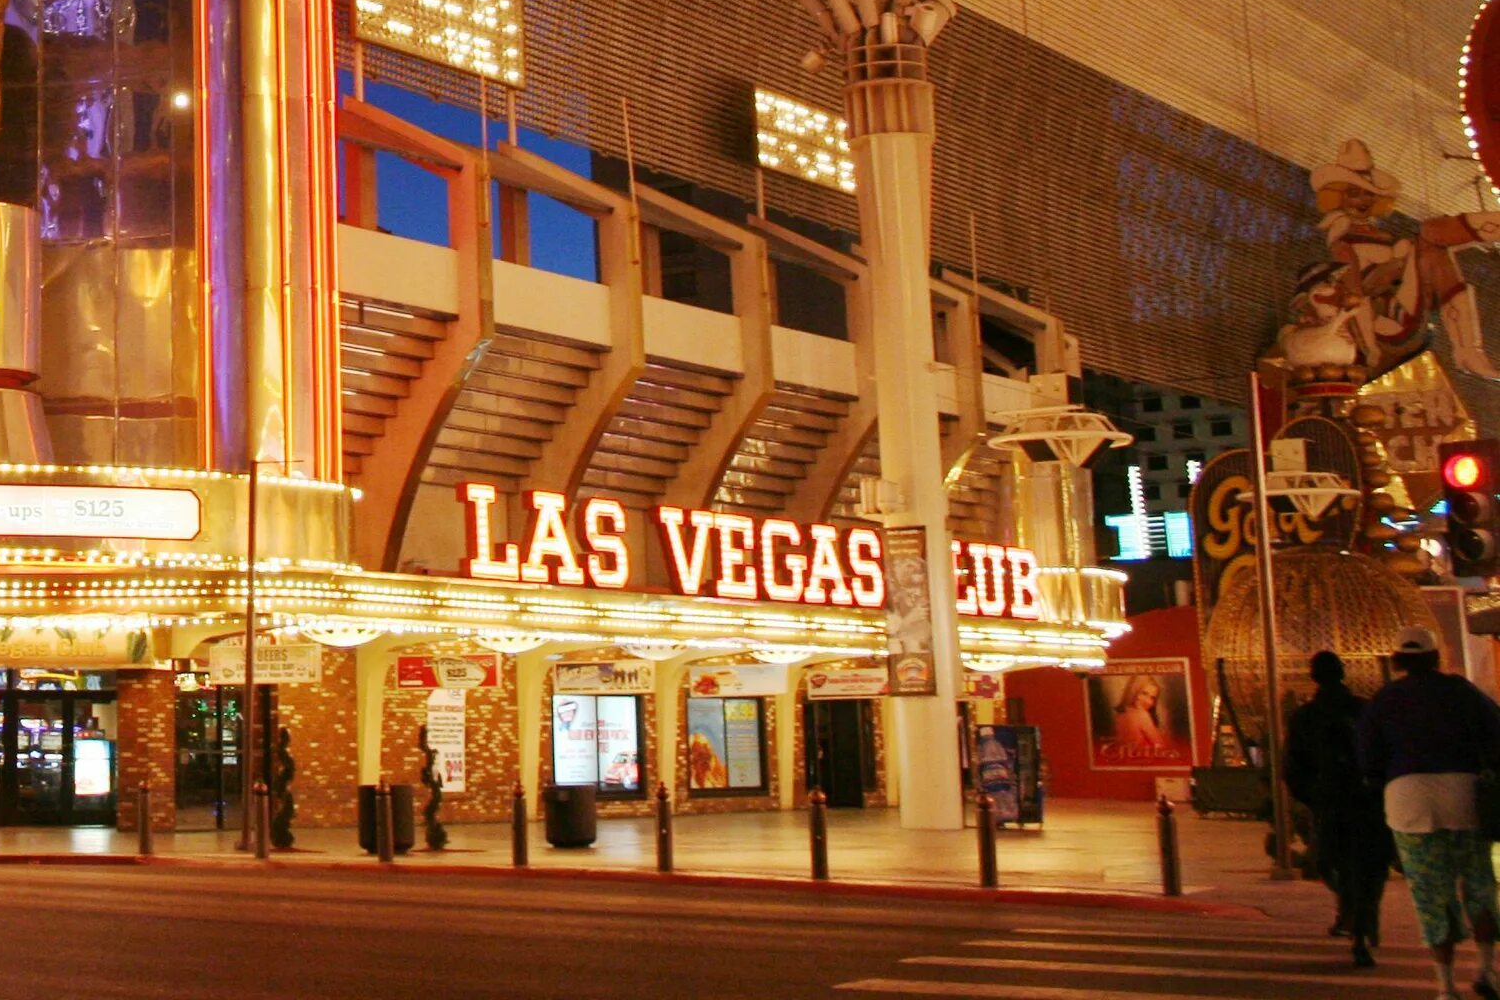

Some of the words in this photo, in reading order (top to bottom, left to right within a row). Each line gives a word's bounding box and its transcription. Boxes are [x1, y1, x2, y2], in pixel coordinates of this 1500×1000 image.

[74, 499, 124, 518] $125
[462, 482, 630, 589] LAS
[656, 504, 886, 608] VEGAS
[952, 540, 1040, 619] LUB
[56, 636, 108, 658] Club
